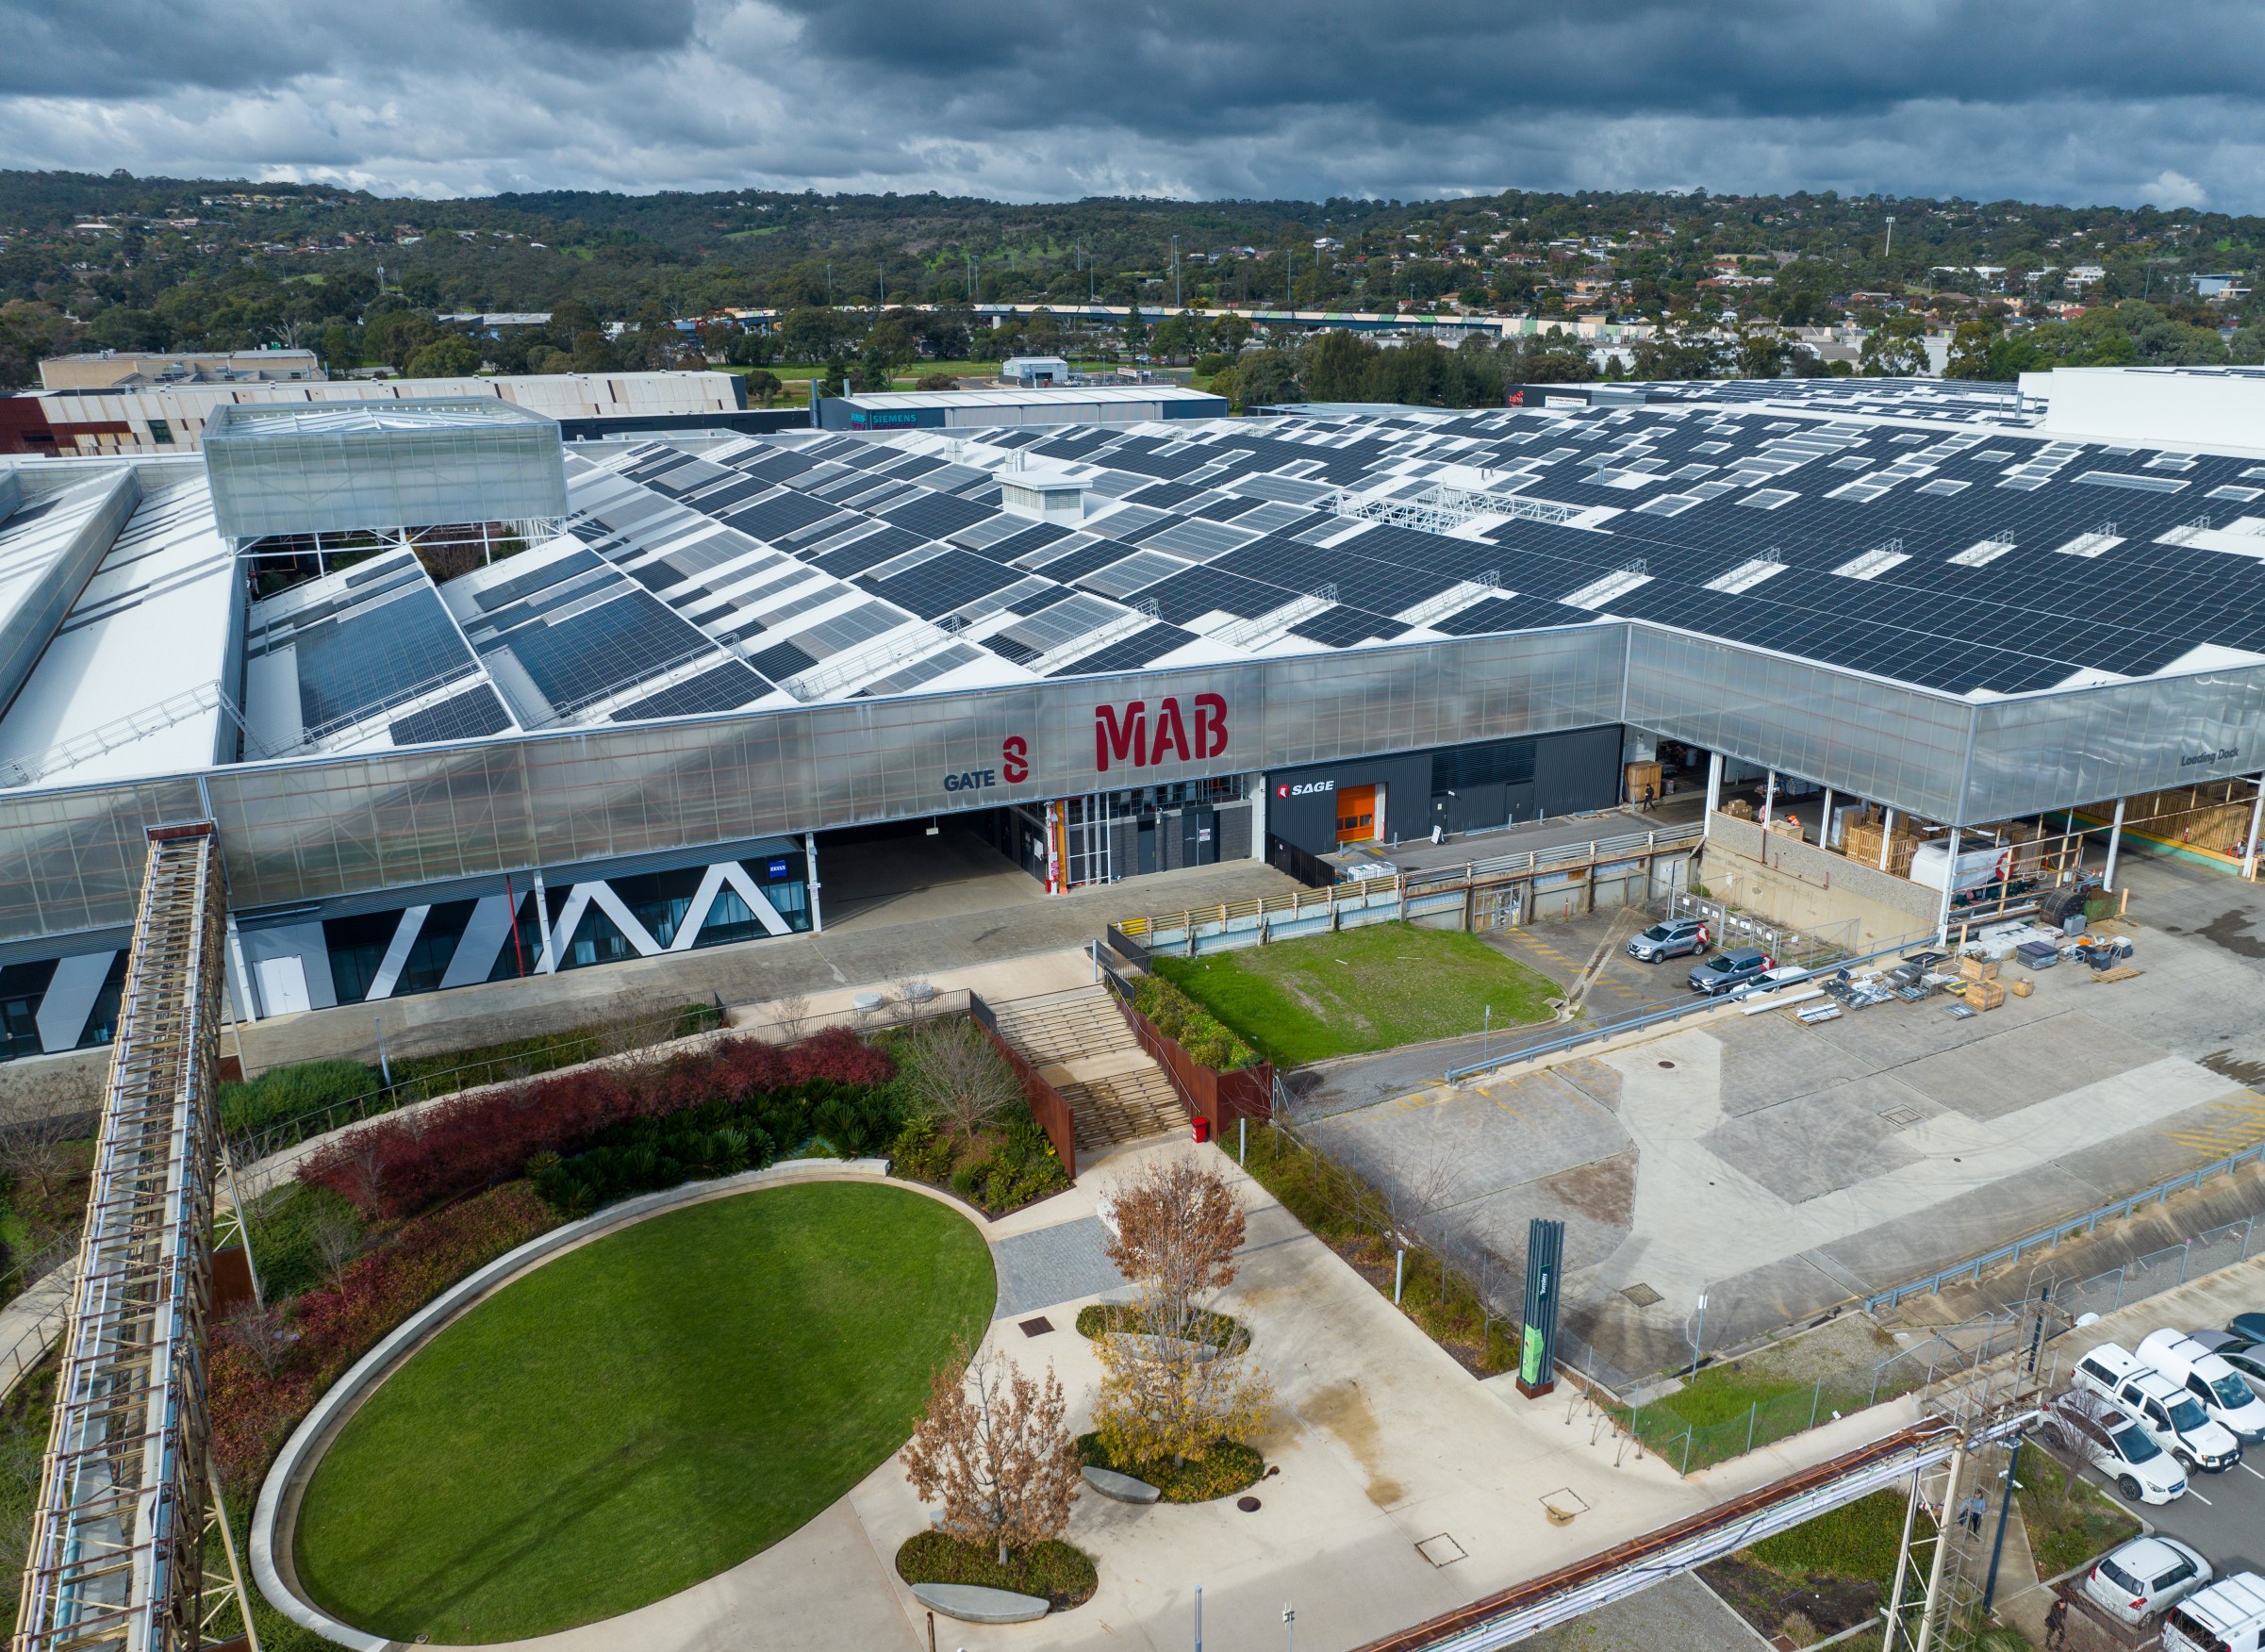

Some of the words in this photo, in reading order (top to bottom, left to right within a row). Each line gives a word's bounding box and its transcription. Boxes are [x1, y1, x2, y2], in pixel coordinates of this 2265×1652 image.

[1095, 693, 1228, 772] MAB
[2181, 752, 2216, 767] Loading
[2218, 748, 2240, 760] Dock
[944, 769, 996, 792] GATE
[1292, 781, 1334, 796] SAGE
